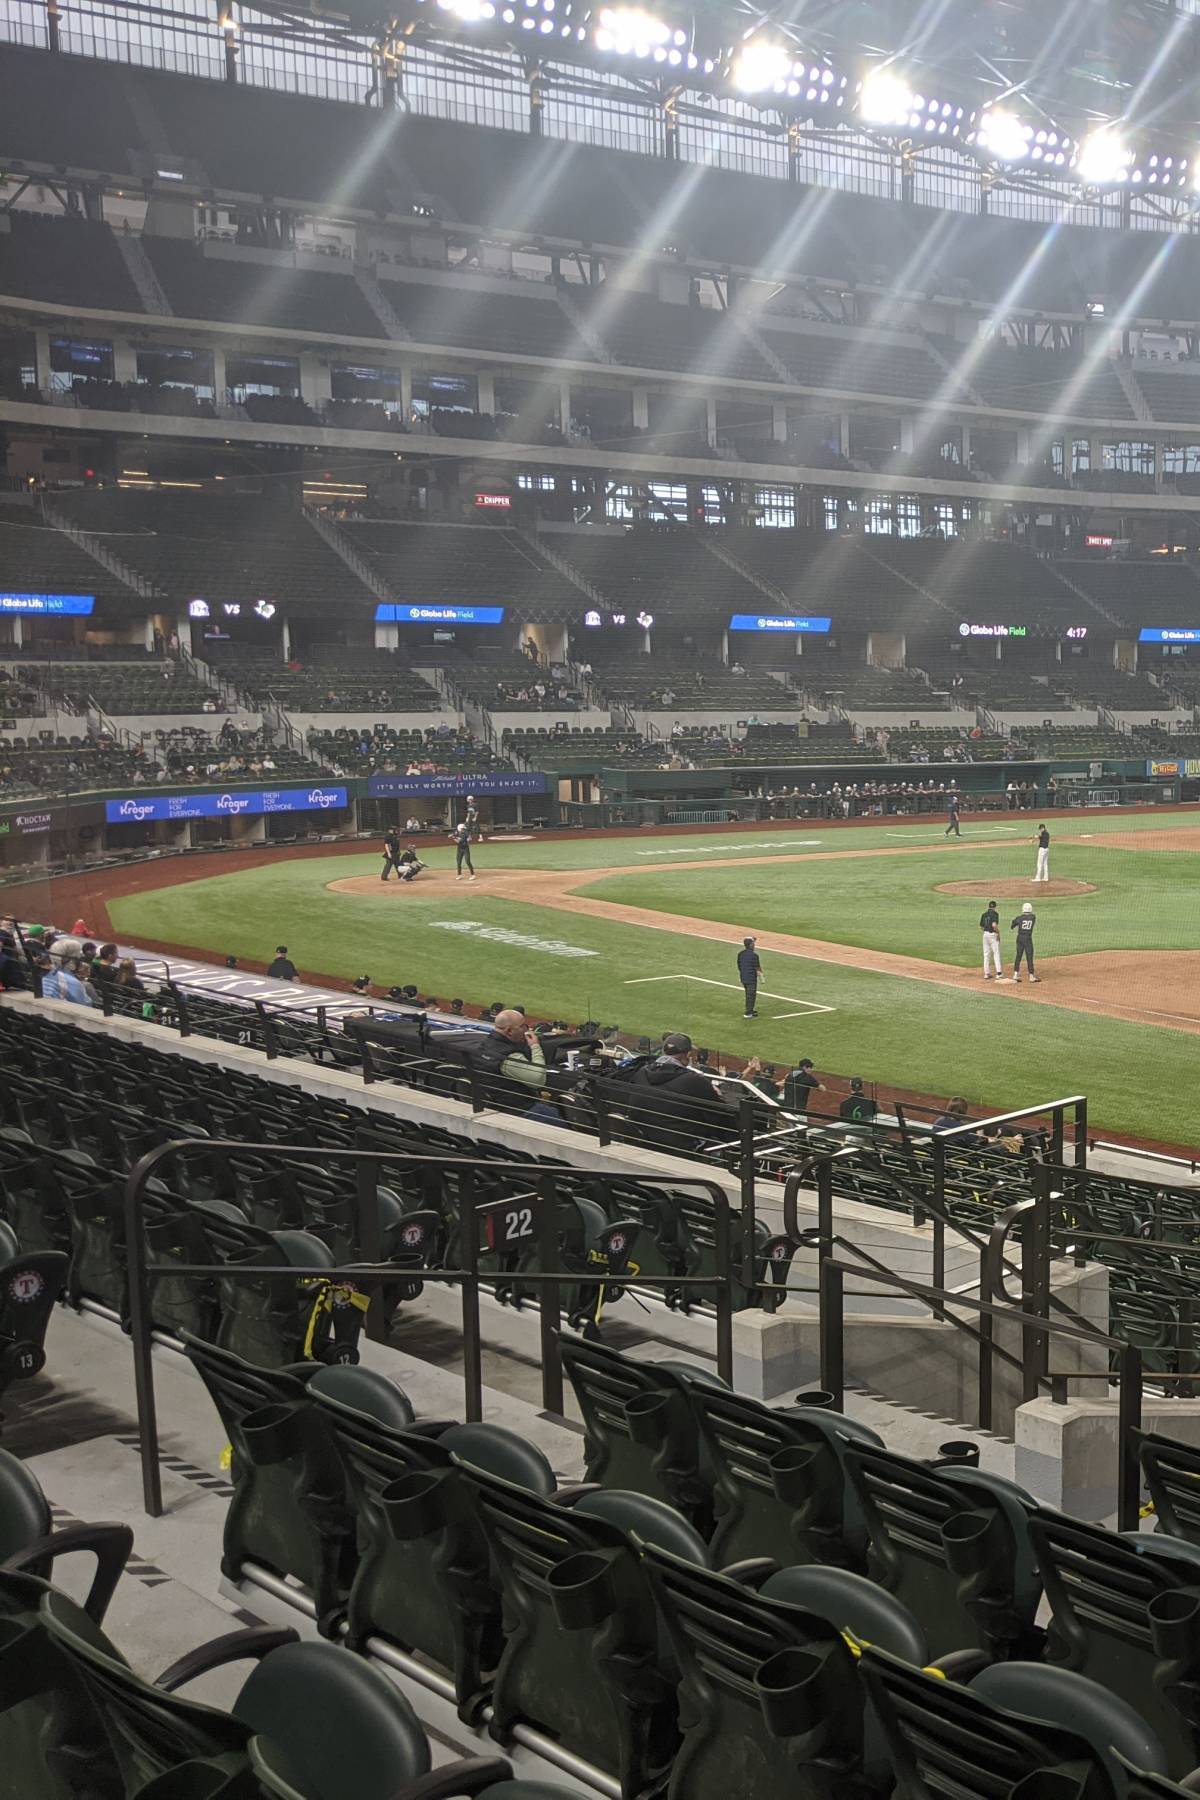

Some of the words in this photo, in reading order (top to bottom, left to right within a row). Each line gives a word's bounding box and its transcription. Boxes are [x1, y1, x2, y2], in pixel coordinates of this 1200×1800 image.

[484, 496, 510, 505] CHIPPER
[421, 609, 441, 619] Globe
[443, 609, 456, 618] Life
[457, 610, 474, 619] Field
[970, 624, 993, 636] Globe
[994, 625, 1009, 636] Life
[1009, 625, 1026, 637] Field
[1066, 627, 1087, 639] 4:17
[263, 792, 280, 800] FRESH
[120, 800, 154, 820] Kroger
[217, 794, 249, 814] Kroger
[308, 789, 338, 808] Kroger
[1021, 920, 1033, 930] 20
[239, 1031, 251, 1044] 21
[505, 1208, 533, 1240] 22
[20, 1354, 33, 1369] 13
